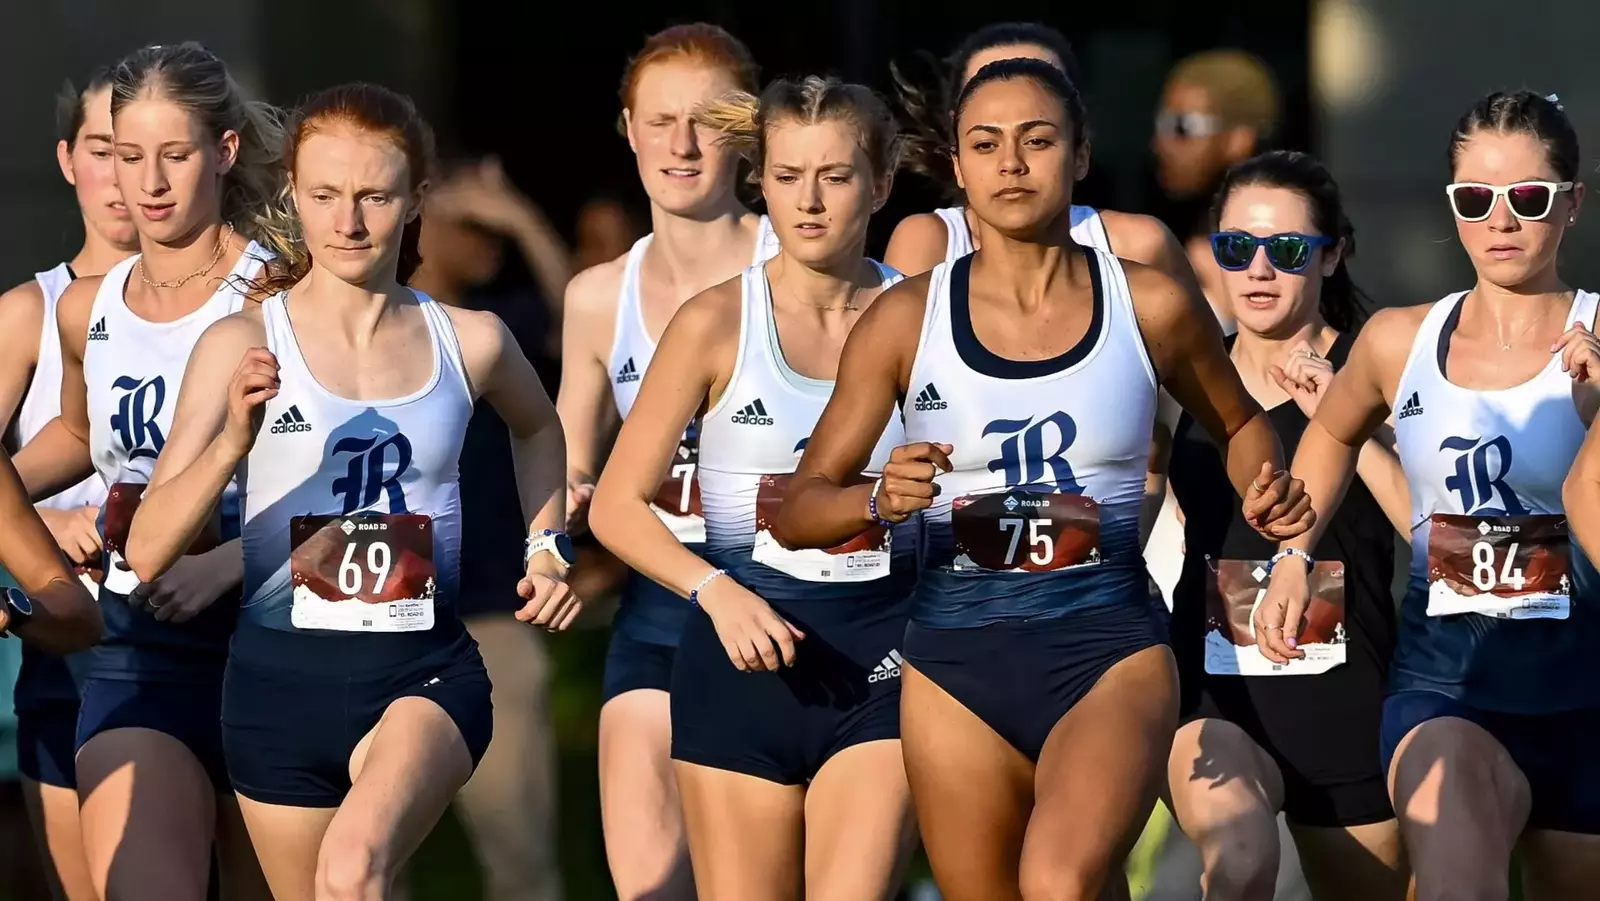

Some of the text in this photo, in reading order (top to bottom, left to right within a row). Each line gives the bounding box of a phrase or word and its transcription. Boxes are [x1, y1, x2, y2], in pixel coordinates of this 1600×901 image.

[731, 413, 774, 426] adidas
[915, 400, 948, 411] adidas
[1399, 406, 1424, 420] adidas
[271, 422, 312, 434] adidas
[981, 410, 1088, 495] R
[332, 432, 416, 515] R
[1439, 434, 1532, 516] R
[358, 523, 379, 531] ROAD
[999, 518, 1054, 566] 75
[1493, 525, 1511, 533] ROAD
[338, 541, 391, 595] 69
[1472, 541, 1526, 592] 84
